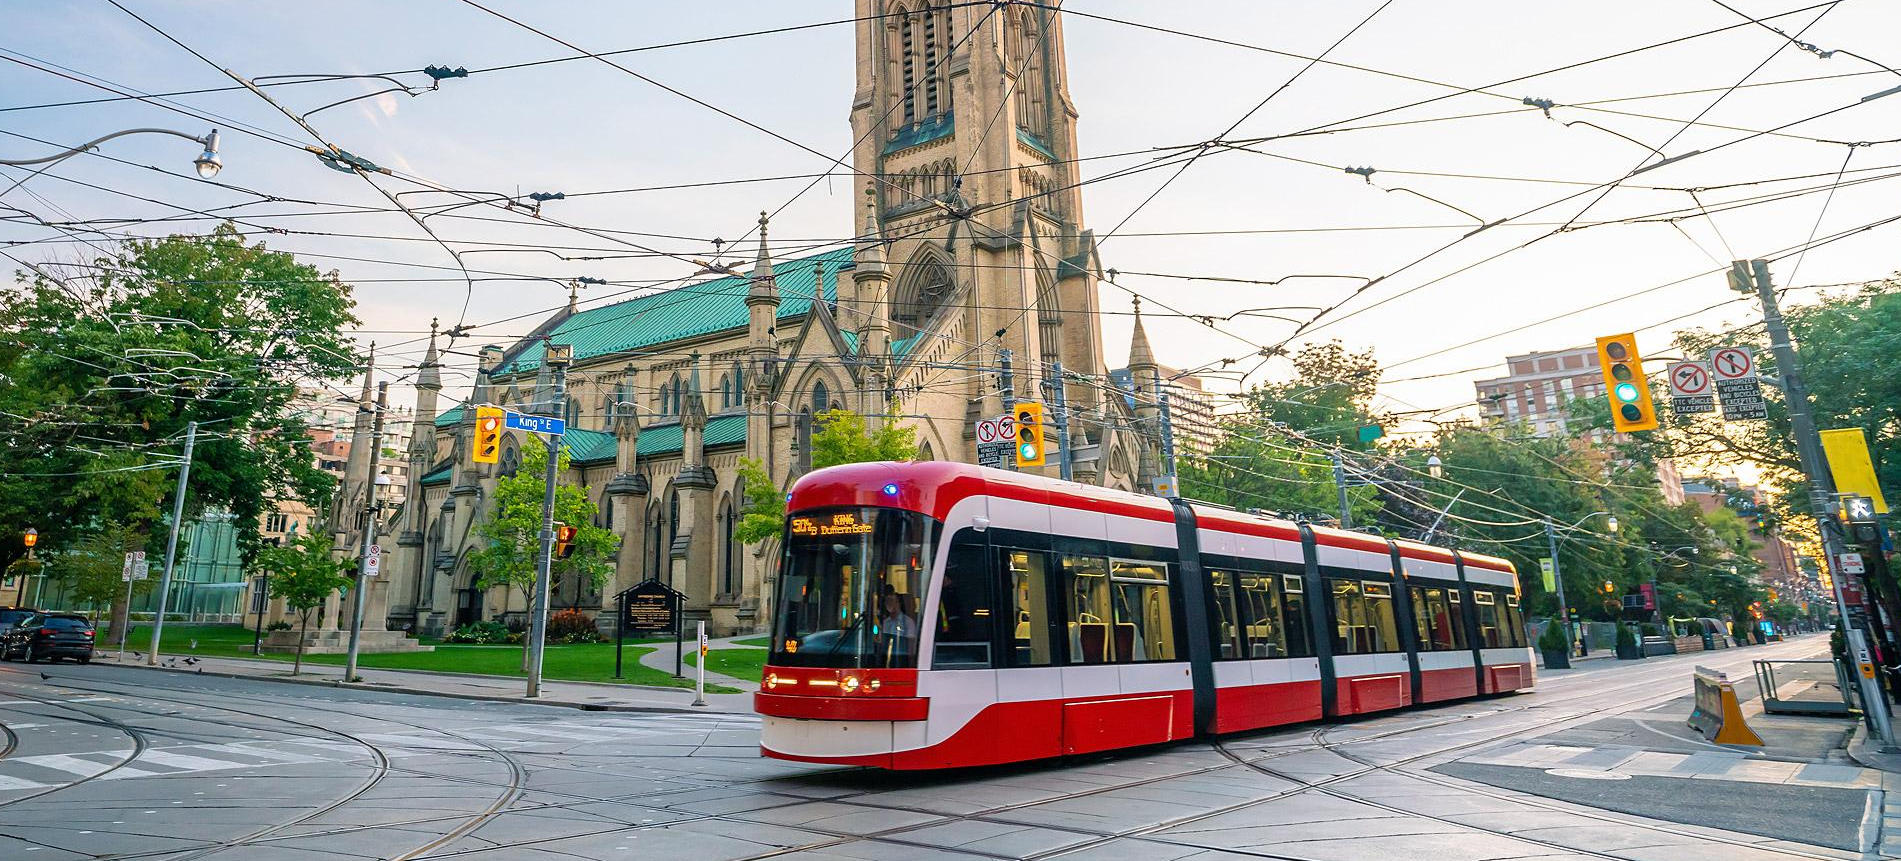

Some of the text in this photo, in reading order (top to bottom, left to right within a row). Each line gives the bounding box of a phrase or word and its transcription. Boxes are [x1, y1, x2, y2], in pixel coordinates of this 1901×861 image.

[1733, 390, 1760, 398] BICYCLES
[520, 417, 538, 430] King
[546, 419, 552, 429] E
[833, 514, 854, 525] KING
[821, 523, 872, 534] Dufferin Gate
